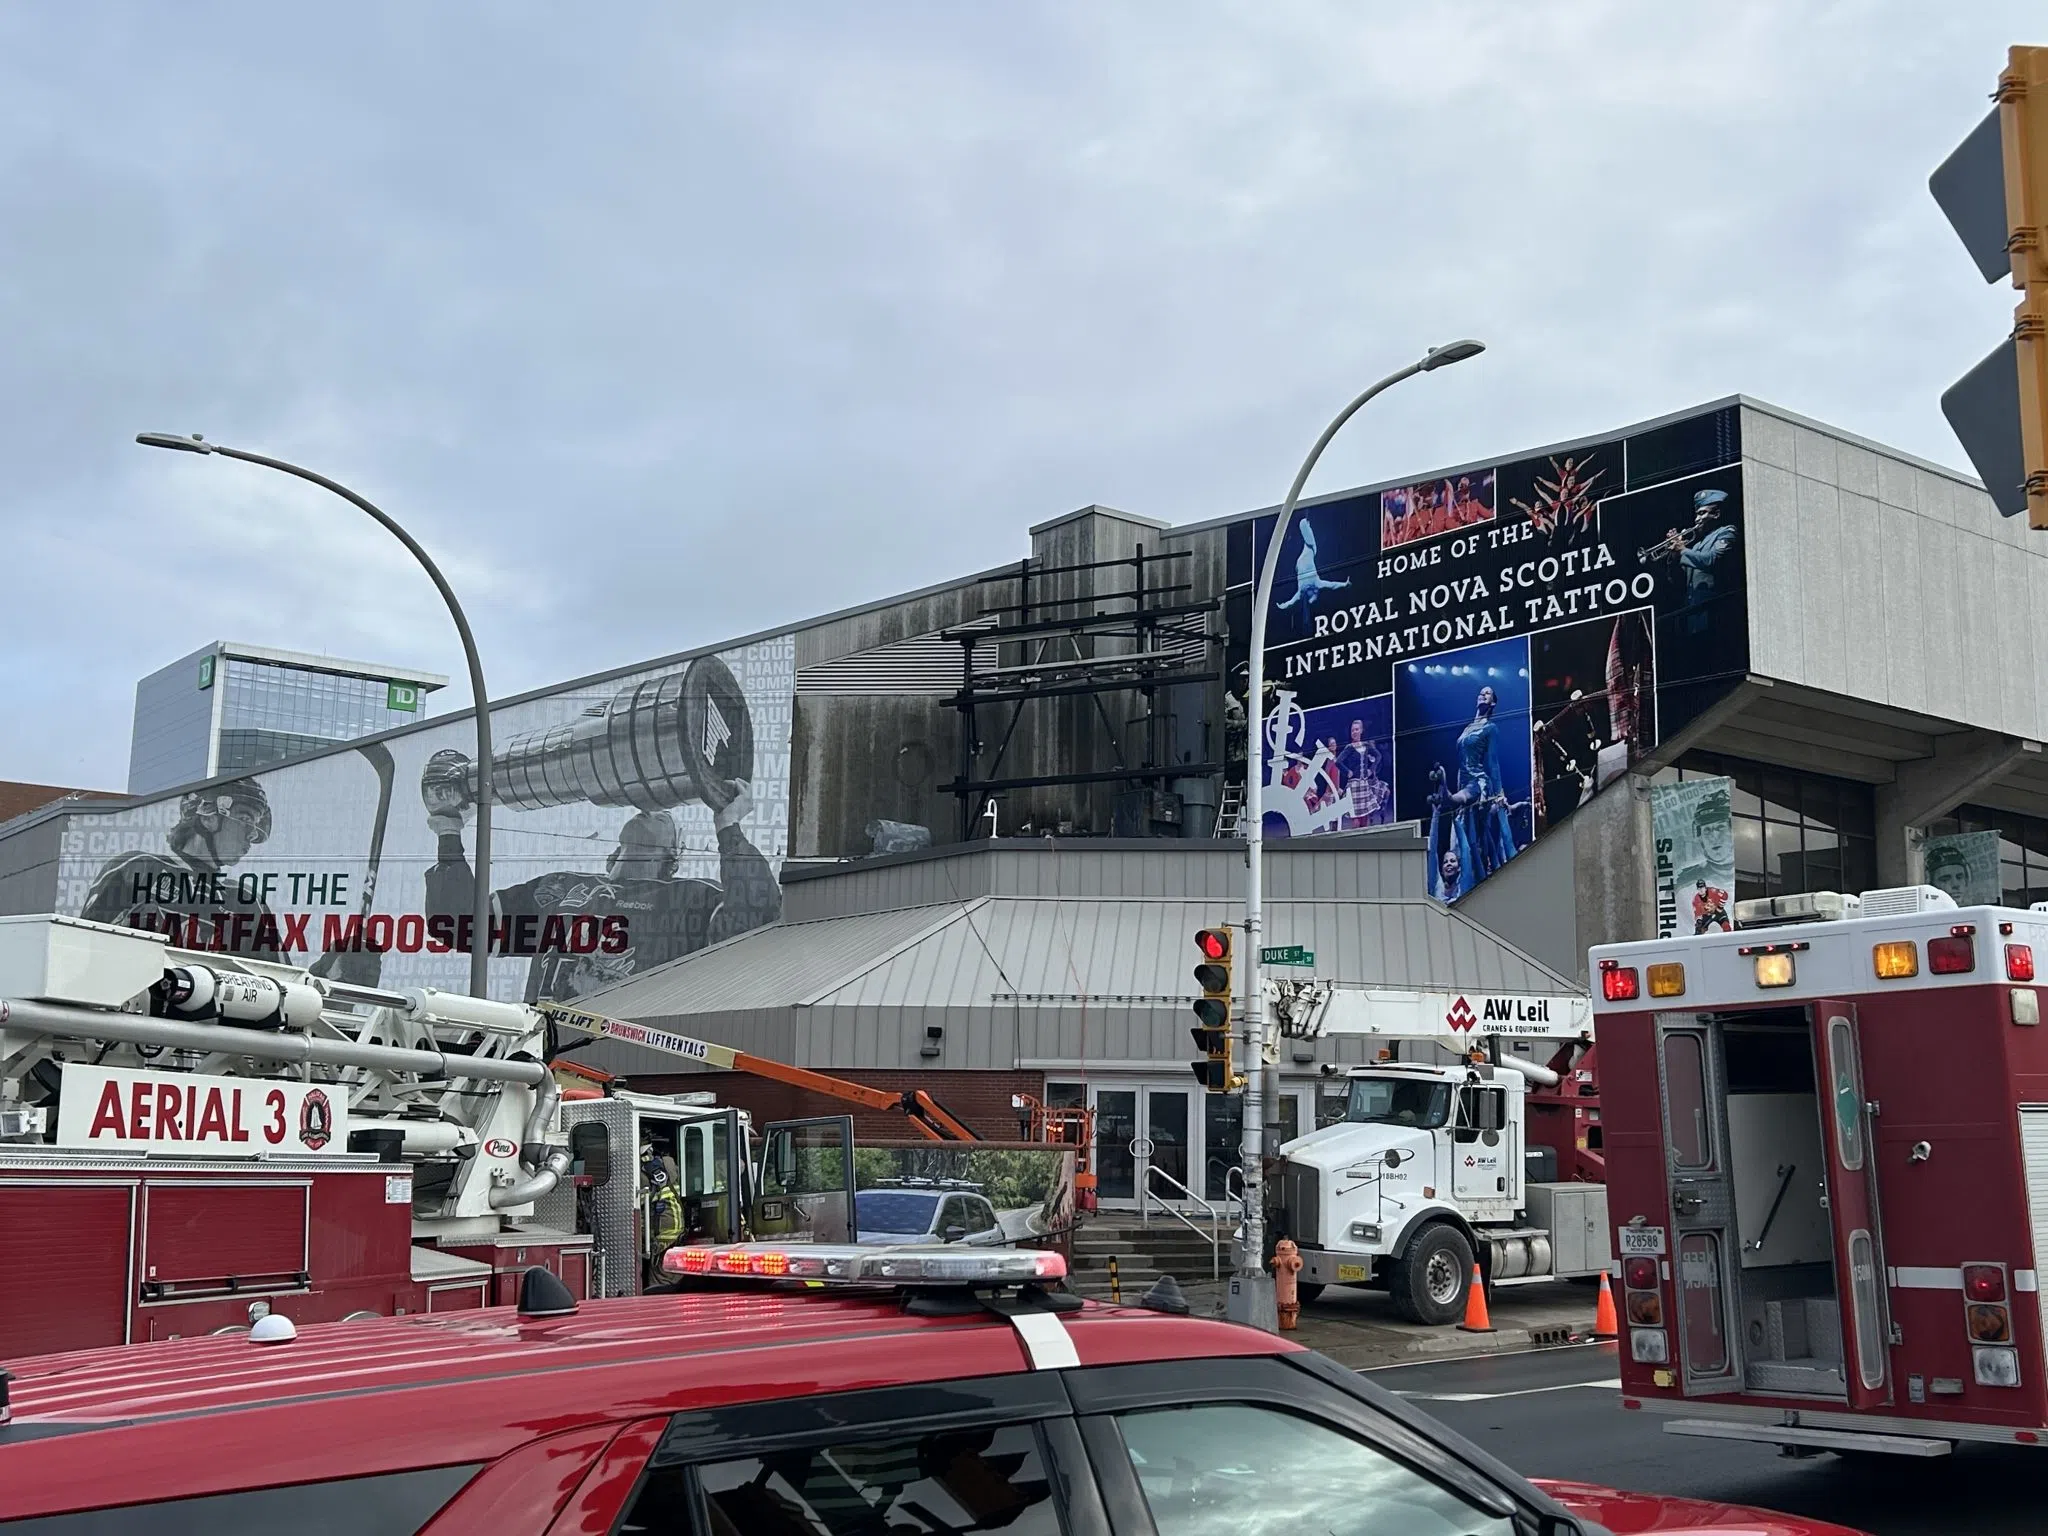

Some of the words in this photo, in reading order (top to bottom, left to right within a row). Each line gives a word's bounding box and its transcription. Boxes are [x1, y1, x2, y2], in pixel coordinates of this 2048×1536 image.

[1377, 545, 1441, 579] HOME
[1450, 535, 1480, 558] OF
[1488, 520, 1533, 548] THE
[1314, 597, 1398, 638] ROYAL
[1409, 575, 1489, 615] NOVA
[1500, 543, 1615, 593] SCOTIA
[1285, 606, 1514, 678] INTERNATIONAL
[1525, 572, 1654, 624] TATTOO
[393, 686, 415, 704] TD
[131, 872, 227, 905] HOME
[237, 873, 279, 905] OF
[287, 873, 349, 906] THE
[1657, 838, 1677, 939] PHILLIPS
[616, 900, 653, 910] Reebok
[322, 914, 630, 954] MOOSEHEADS
[1264, 949, 1289, 961] DUKE
[220, 974, 272, 991] BREATHING
[242, 988, 258, 1003] AIR
[1484, 999, 1513, 1021] AW
[1518, 1000, 1550, 1022] Leil
[552, 1009, 567, 1021] JLG
[569, 1014, 595, 1029] LIFT
[610, 1022, 646, 1042] BRUNSWICK
[1483, 1025, 1507, 1033] CRANES
[1515, 1026, 1550, 1034] EQUIPMENT
[88, 1080, 249, 1142] AERIAL
[263, 1089, 287, 1144] 3
[1626, 1235, 1658, 1248] R28588
